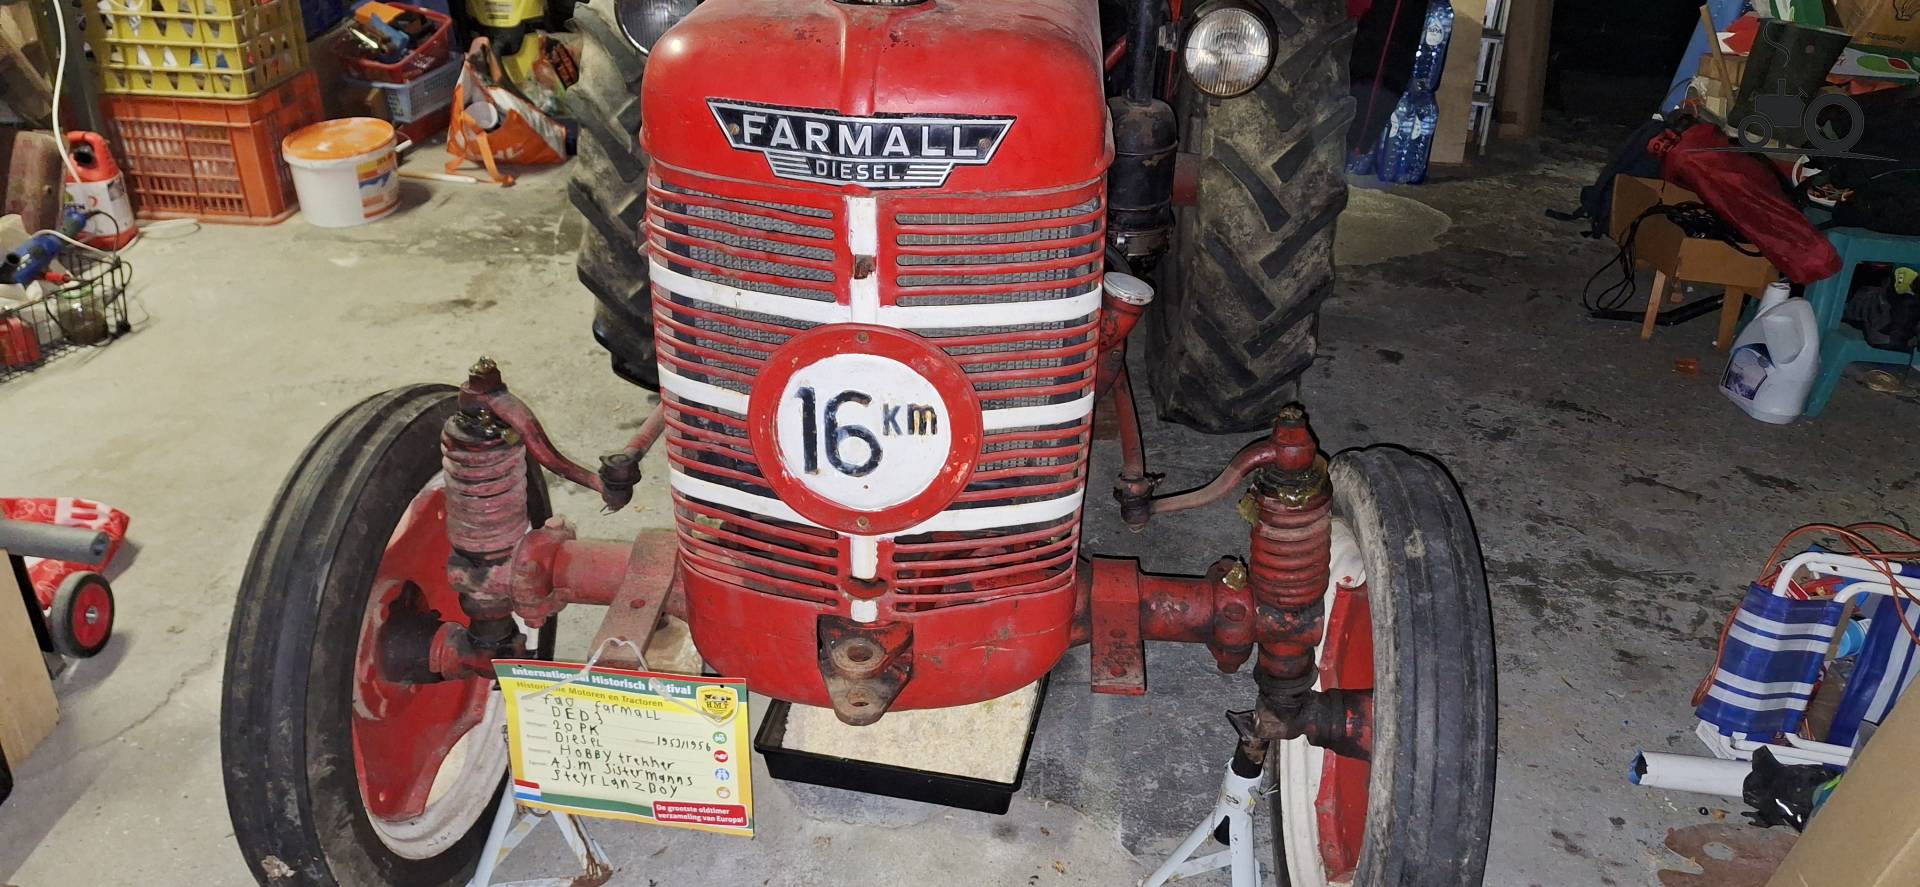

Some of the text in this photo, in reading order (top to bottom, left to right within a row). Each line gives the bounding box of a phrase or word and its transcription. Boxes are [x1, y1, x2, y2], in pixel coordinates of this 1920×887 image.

[742, 113, 978, 157] FARMALL
[815, 161, 902, 180] DIESEL
[794, 386, 883, 477] 16
[591, 675, 646, 690] Historisch
[648, 680, 692, 695] Ftival
[568, 687, 606, 700] Motoren
[608, 694, 619, 702] en
[622, 695, 663, 708] Tractoren
[580, 722, 599, 736] PK
[655, 804, 730, 815] De grootste oldtimer
[657, 812, 702, 823] verzameling
[716, 816, 744, 825] Europa!
